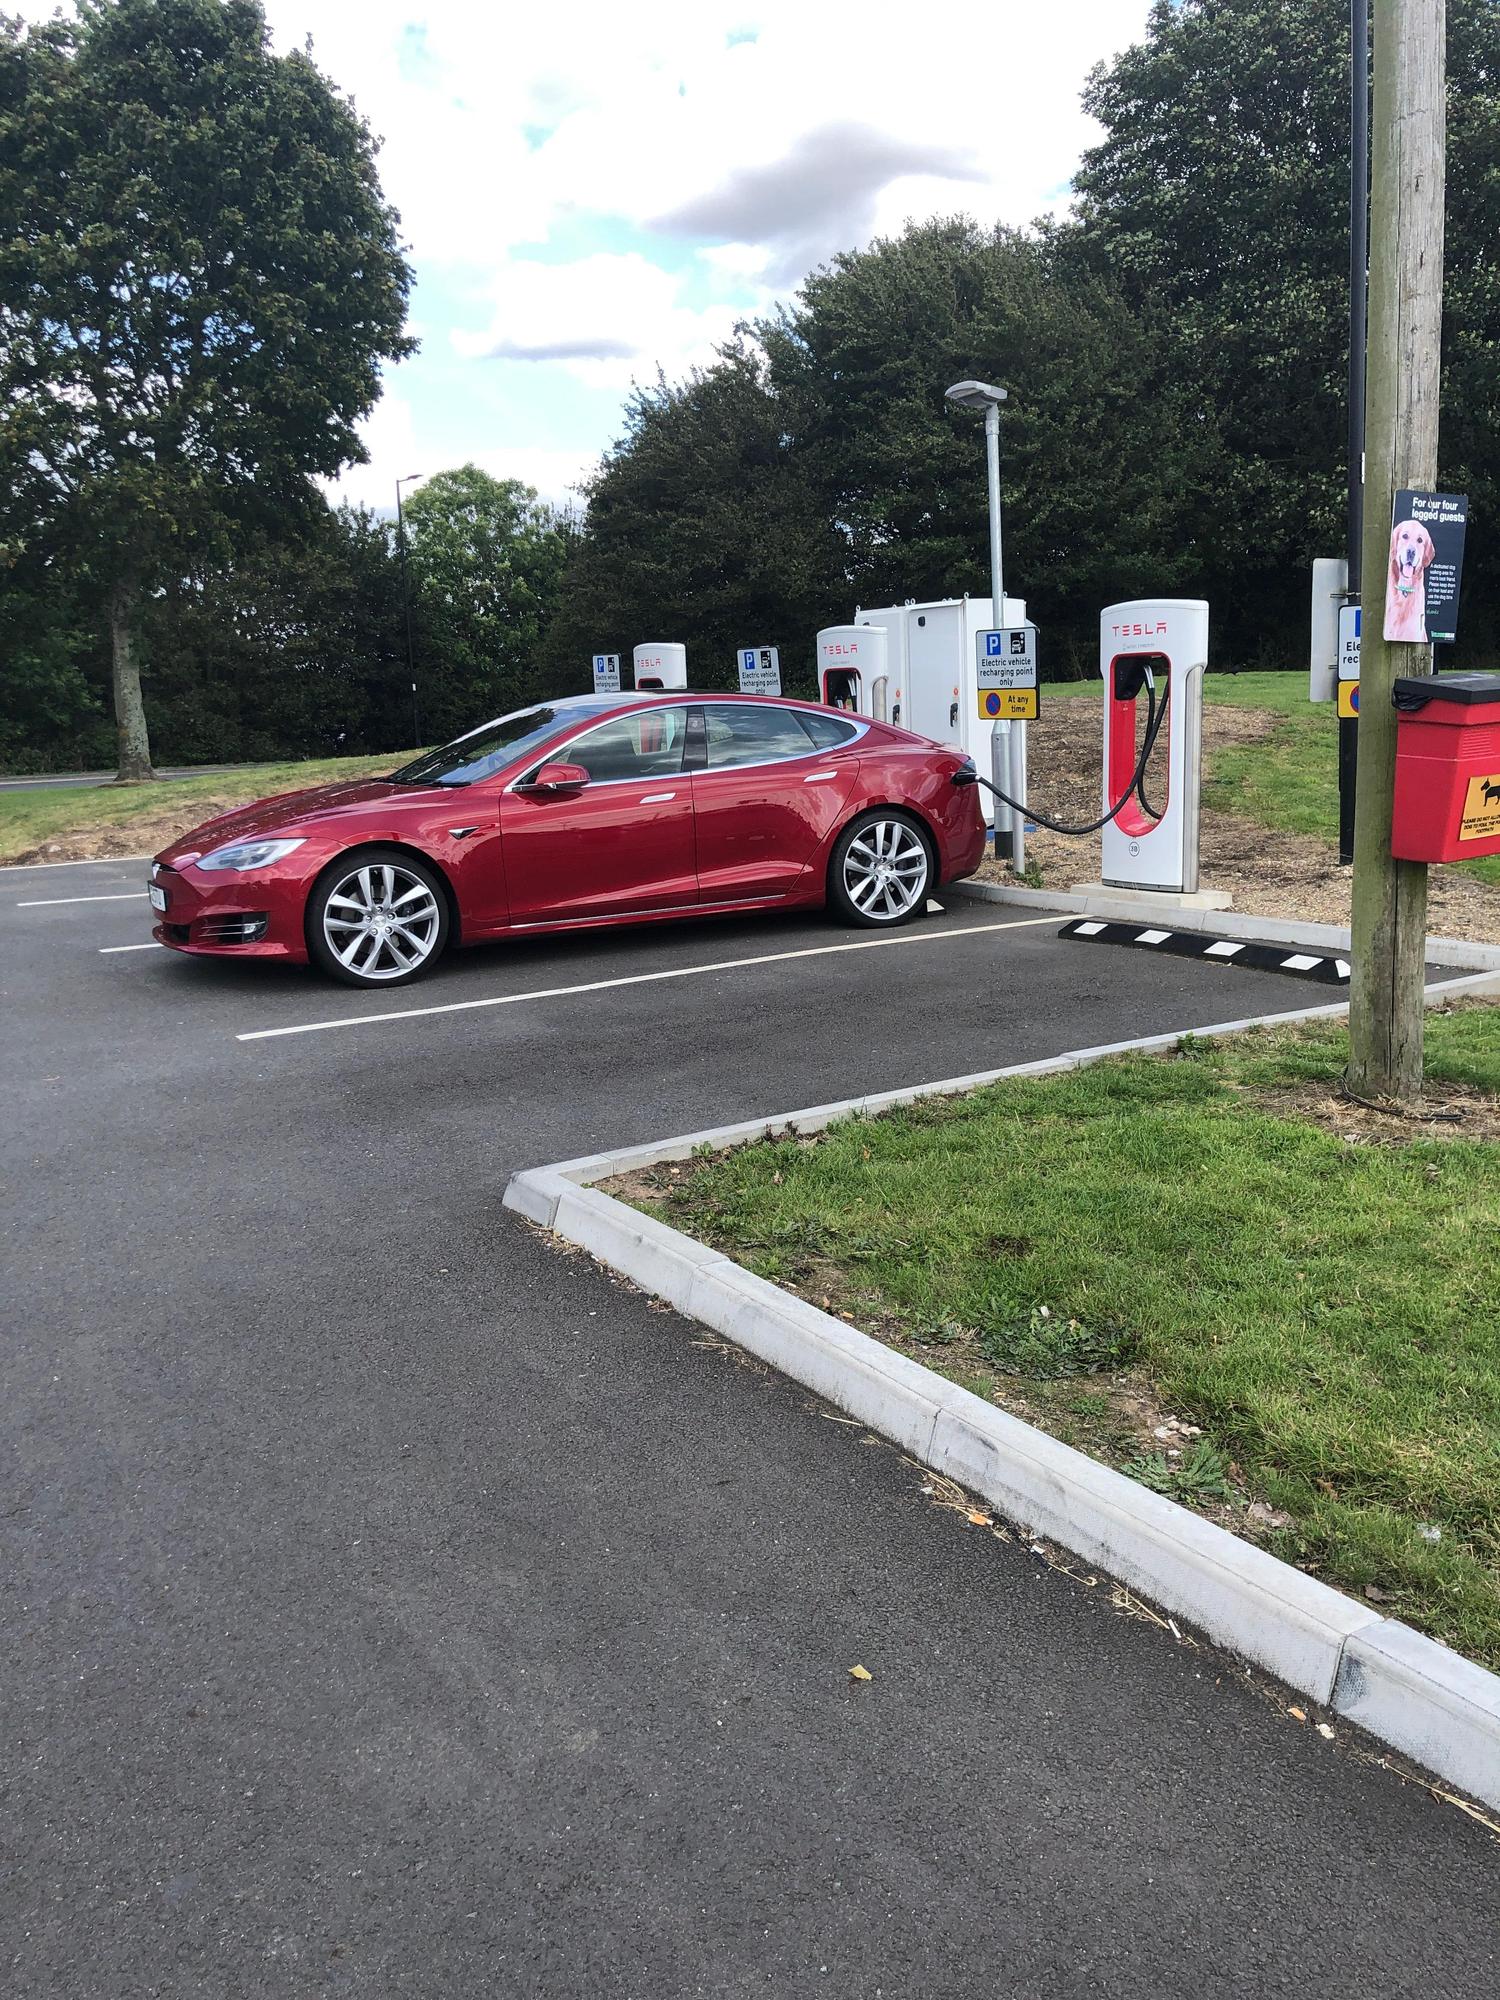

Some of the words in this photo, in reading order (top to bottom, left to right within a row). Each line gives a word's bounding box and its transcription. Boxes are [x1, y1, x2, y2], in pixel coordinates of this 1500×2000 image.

[1412, 497, 1426, 508] For
[1428, 500, 1440, 509] our
[1442, 500, 1458, 510] four
[1412, 508, 1438, 521] legged
[1440, 513, 1465, 522] guests
[1112, 622, 1166, 636] TESLA
[823, 644, 858, 655] TESLA
[1008, 658, 1031, 666] vehicle
[980, 668, 1014, 677] recharging
[1016, 667, 1032, 676] point
[1000, 678, 1013, 686] only
[1017, 696, 1028, 704] any
